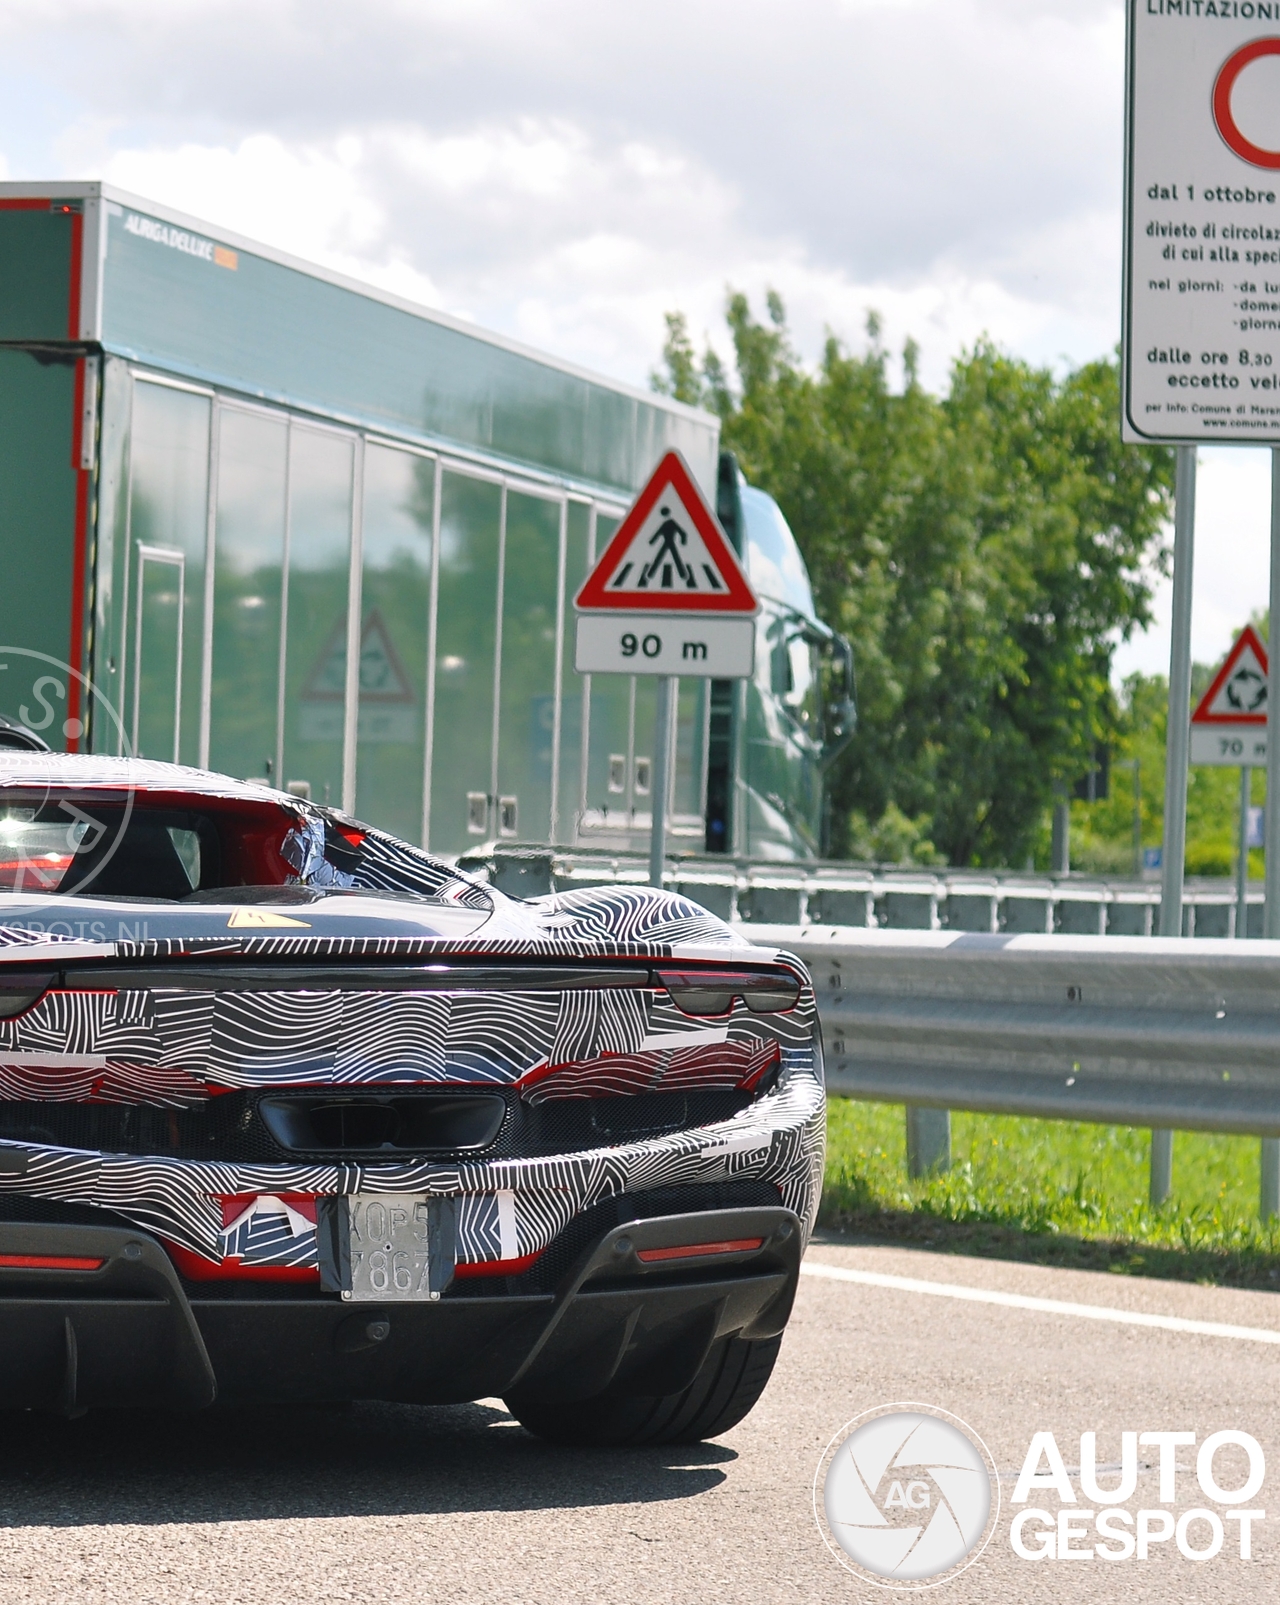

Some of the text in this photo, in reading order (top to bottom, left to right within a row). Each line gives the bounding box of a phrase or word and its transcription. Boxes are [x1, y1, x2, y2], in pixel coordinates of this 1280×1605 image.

[1148, 184, 1276, 203] dal 1 ottobre
[1146, 221, 1197, 238] divieto
[1203, 222, 1216, 239] di
[1162, 243, 1176, 260] di
[1182, 244, 1204, 261] cui
[1210, 245, 1239, 262] alla
[1149, 279, 1170, 291] nel
[1179, 279, 1224, 293] giorni:
[1265, 281, 1280, 294] lu
[1234, 298, 1280, 312] -dome
[1148, 347, 1273, 367] dalle ore 8.30
[1168, 373, 1280, 390] eccetto vel
[1146, 404, 1161, 414] per
[1192, 403, 1231, 414] Comune
[1236, 404, 1246, 415] di
[1203, 419, 1280, 429] www.comune.m
[621, 633, 707, 660] 90 m
[1219, 737, 1243, 757] 70
